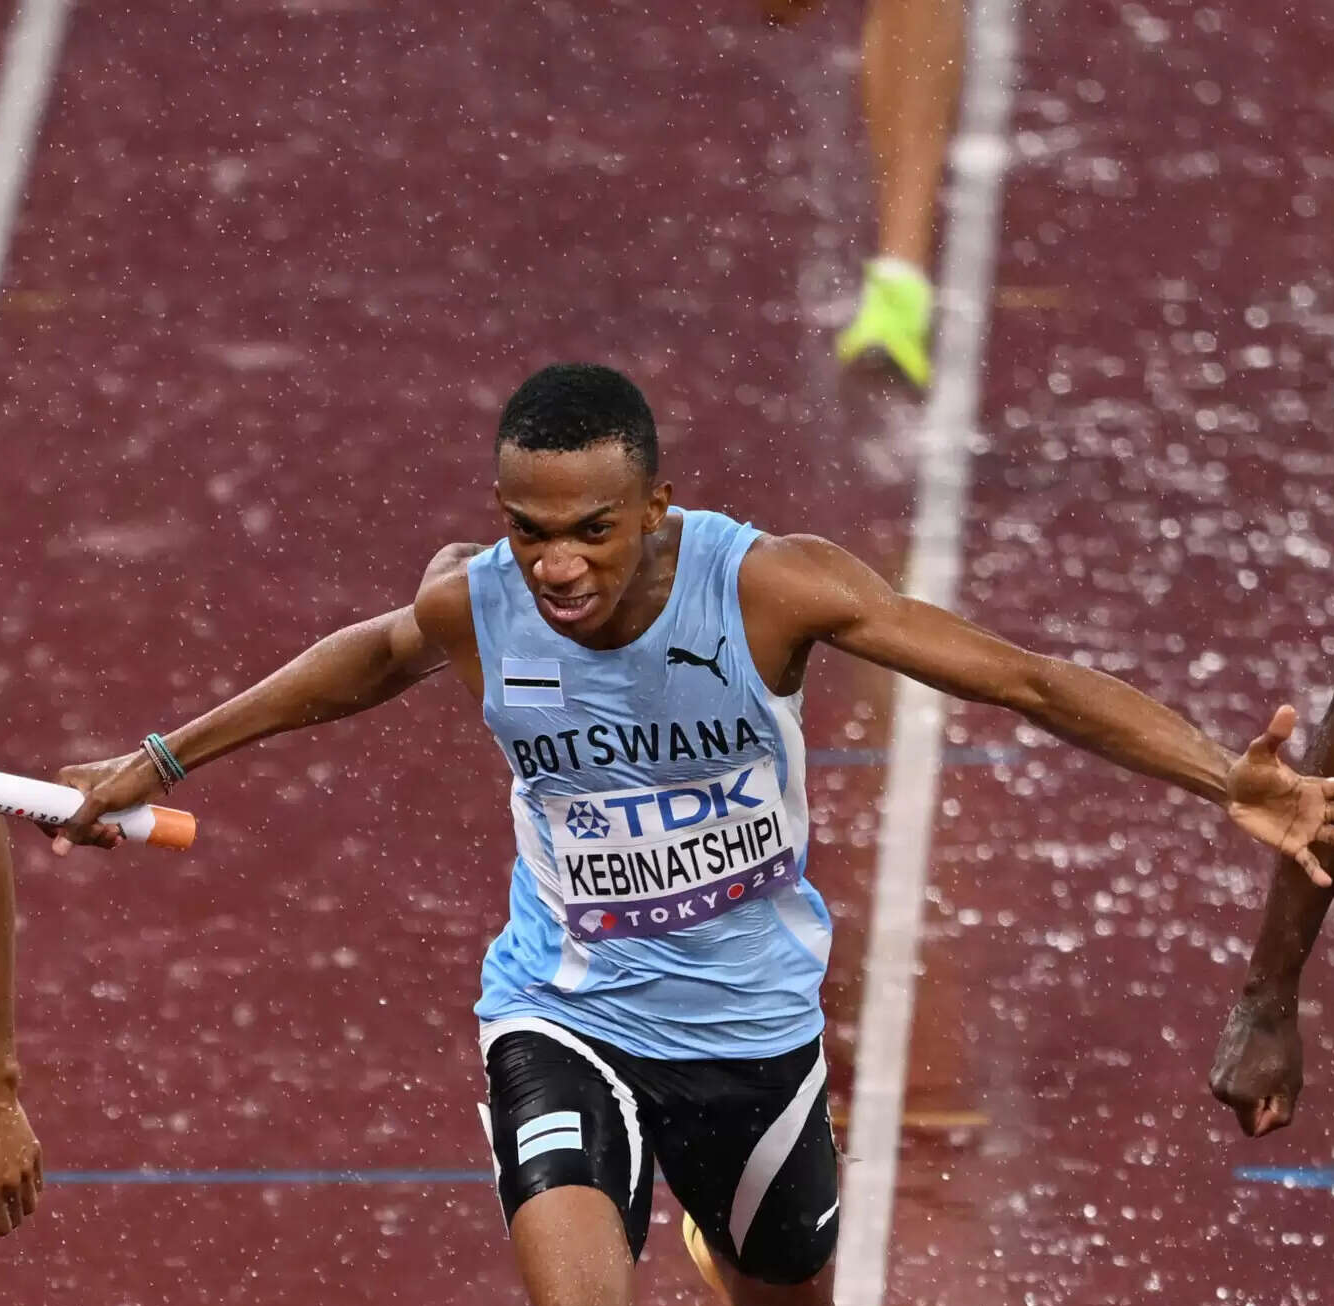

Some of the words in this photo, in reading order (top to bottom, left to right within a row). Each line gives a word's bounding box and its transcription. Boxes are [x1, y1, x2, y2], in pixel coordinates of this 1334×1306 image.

[512, 717, 760, 779] BOTSWANA
[604, 767, 765, 838] TDK
[565, 811, 783, 897] KEBINATSHIPI
[752, 862, 786, 888] 25
